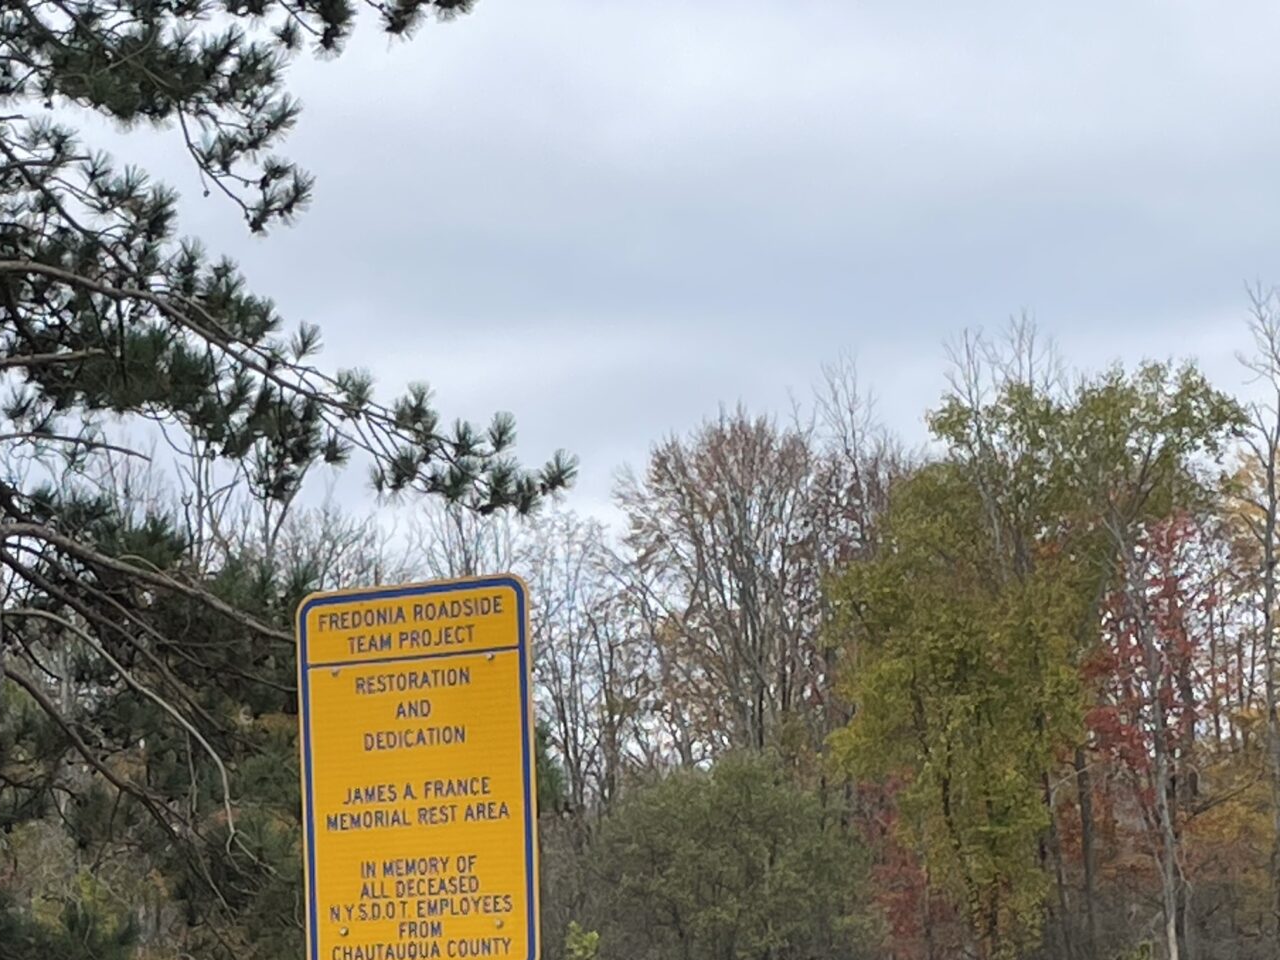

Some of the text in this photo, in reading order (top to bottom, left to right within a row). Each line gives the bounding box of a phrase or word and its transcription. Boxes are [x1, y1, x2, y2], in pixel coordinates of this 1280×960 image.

[318, 595, 504, 632] FREDONIA ROADSIDE
[348, 624, 476, 654] TEAM PROJECT
[355, 666, 471, 695] RESTORATION
[395, 699, 431, 720] AND
[363, 725, 466, 751] DEDICATION
[343, 784, 397, 805] JAMES
[424, 776, 492, 799] FRANCE
[326, 801, 510, 831] MEMORIAL REST AREA
[361, 855, 478, 879] IN MEMORY OF
[361, 875, 480, 900] ALL DECEASED
[417, 895, 514, 919] EMPLOYEES
[398, 922, 443, 939] FROM
[446, 938, 512, 958] COUNTY
